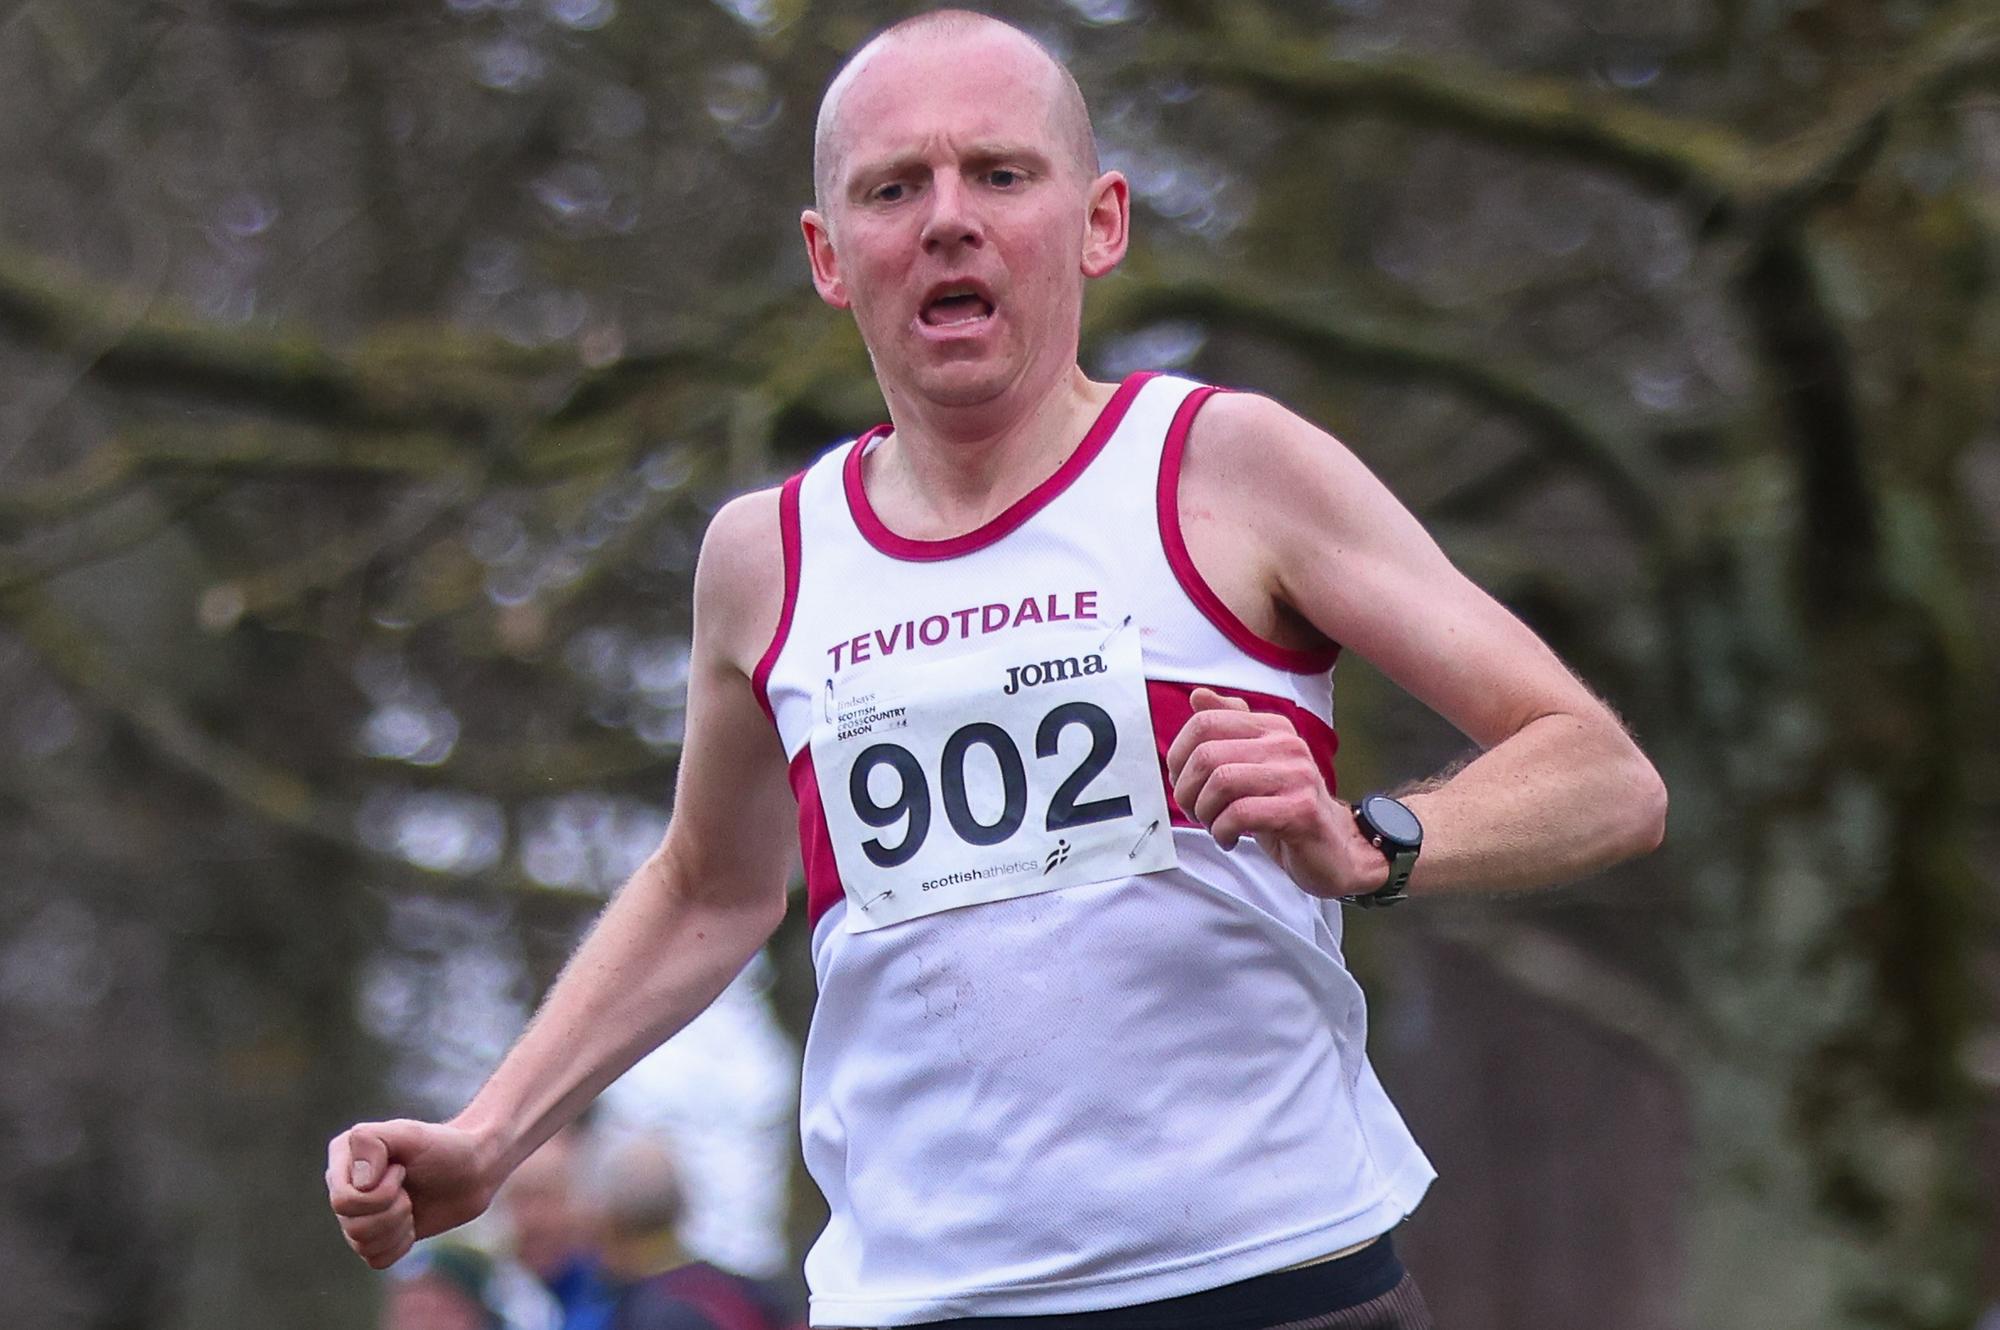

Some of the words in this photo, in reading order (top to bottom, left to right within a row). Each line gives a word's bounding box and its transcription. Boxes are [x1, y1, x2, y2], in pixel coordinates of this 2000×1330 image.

[827, 591, 1098, 673] TEVIOTDALE
[838, 706, 876, 723] SCOTTISH
[838, 725, 872, 741] SEASON
[849, 701, 1133, 869] 902
